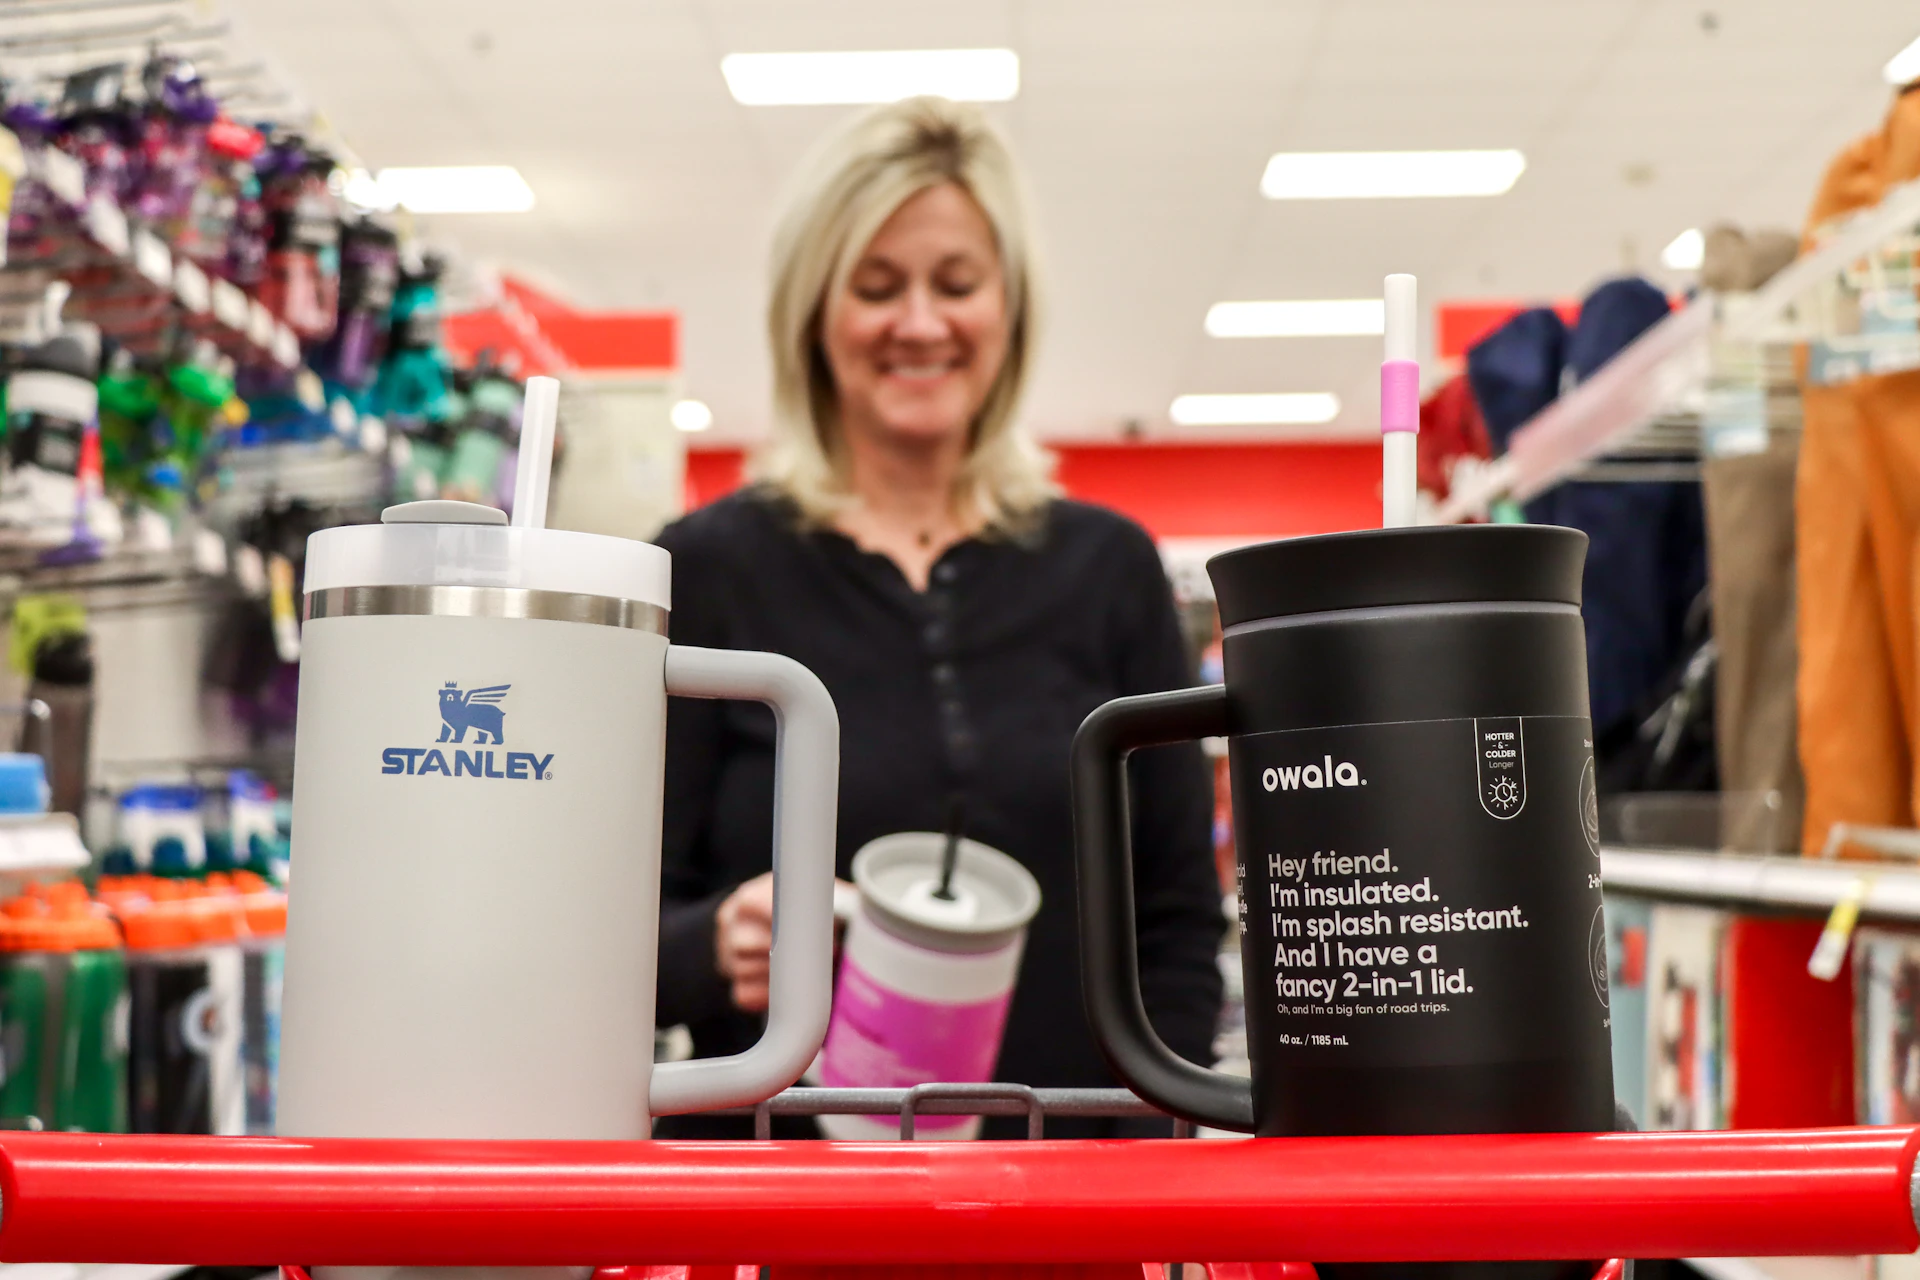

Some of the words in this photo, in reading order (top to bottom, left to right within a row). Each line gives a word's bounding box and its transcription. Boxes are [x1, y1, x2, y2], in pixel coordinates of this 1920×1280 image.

[1485, 732, 1515, 741] HOTTER
[1485, 749, 1517, 759] COLDER
[1488, 761, 1514, 770] Longer
[1268, 853, 1307, 883] Hey
[1311, 847, 1399, 876] friend.
[1270, 882, 1299, 907] I'm
[1303, 876, 1440, 907] insulated.
[1271, 912, 1302, 937] I'm
[1306, 909, 1392, 943] splash
[1399, 904, 1529, 934] resistant.
[1273, 942, 1317, 967] And
[1323, 942, 1331, 967] I
[1337, 941, 1410, 967] have
[1417, 944, 1438, 965] a
[1275, 972, 1337, 1004] fancy
[1342, 969, 1423, 997] 2-in-1
[1430, 967, 1474, 995] lid.
[1277, 1003, 1291, 1015] Oh,
[1291, 1003, 1309, 1014] and
[1310, 1004, 1325, 1015] I'm
[1326, 1006, 1334, 1015] a
[1335, 1004, 1353, 1017] big
[1355, 1003, 1374, 1014] fan
[1375, 1002, 1388, 1014] of
[1390, 1002, 1418, 1014] road
[1420, 1002, 1450, 1015] trips.
[1279, 1033, 1290, 1045] 40
[1290, 1036, 1303, 1045] oz.
[1311, 1034, 1332, 1046] 1185
[1333, 1034, 1349, 1046] mL
